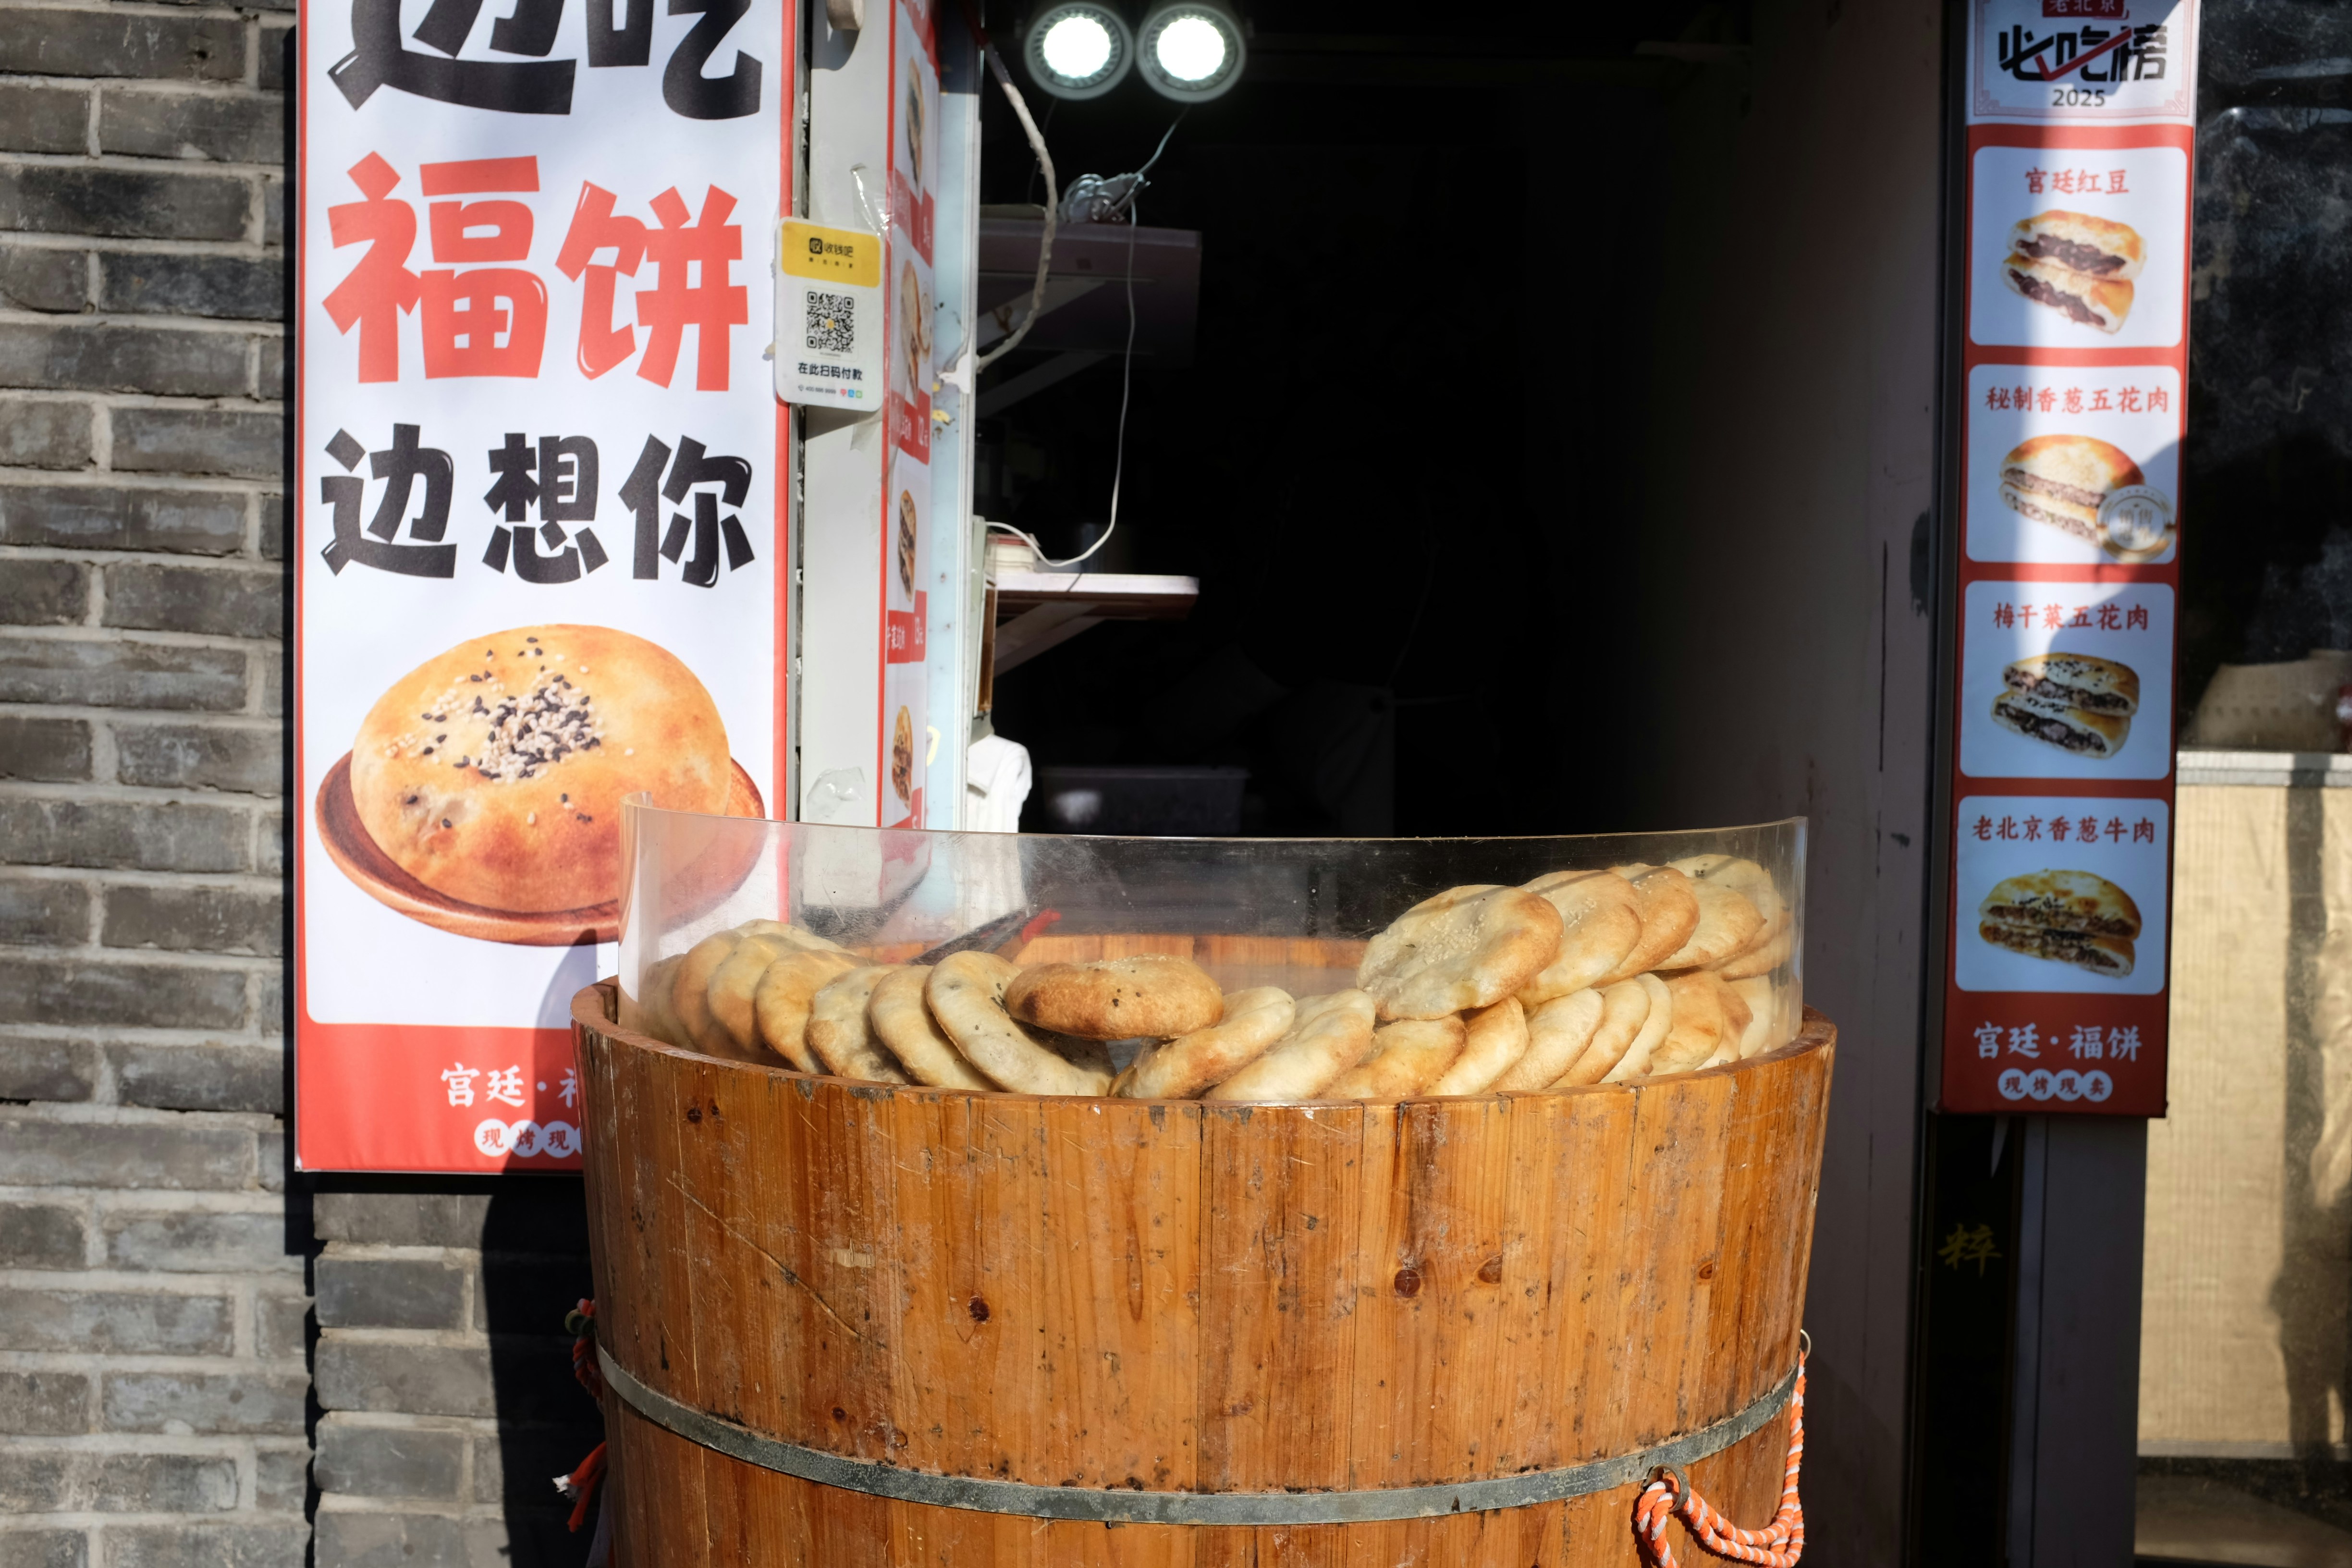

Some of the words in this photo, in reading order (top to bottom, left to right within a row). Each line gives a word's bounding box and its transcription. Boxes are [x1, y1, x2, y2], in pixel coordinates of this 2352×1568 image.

[1999, 24, 2167, 82] 必吃榜
[2052, 89, 2106, 107] 2025
[2024, 167, 2130, 195] 宫廷红豆
[322, 151, 748, 391] 福饼
[798, 362, 862, 381] 在此扫码付款
[1984, 386, 2169, 414] 秘制香葱五花肉
[320, 423, 755, 588] 边想你
[1993, 602, 2149, 630] 梅干菜五花肉
[1972, 815, 2155, 844] 老北京香葱牛肉
[1973, 1021, 2142, 1062] 宫廷·福饼
[2004, 1076, 2106, 1095] 现烤现卖
[482, 1128, 570, 1150] 现烤现
